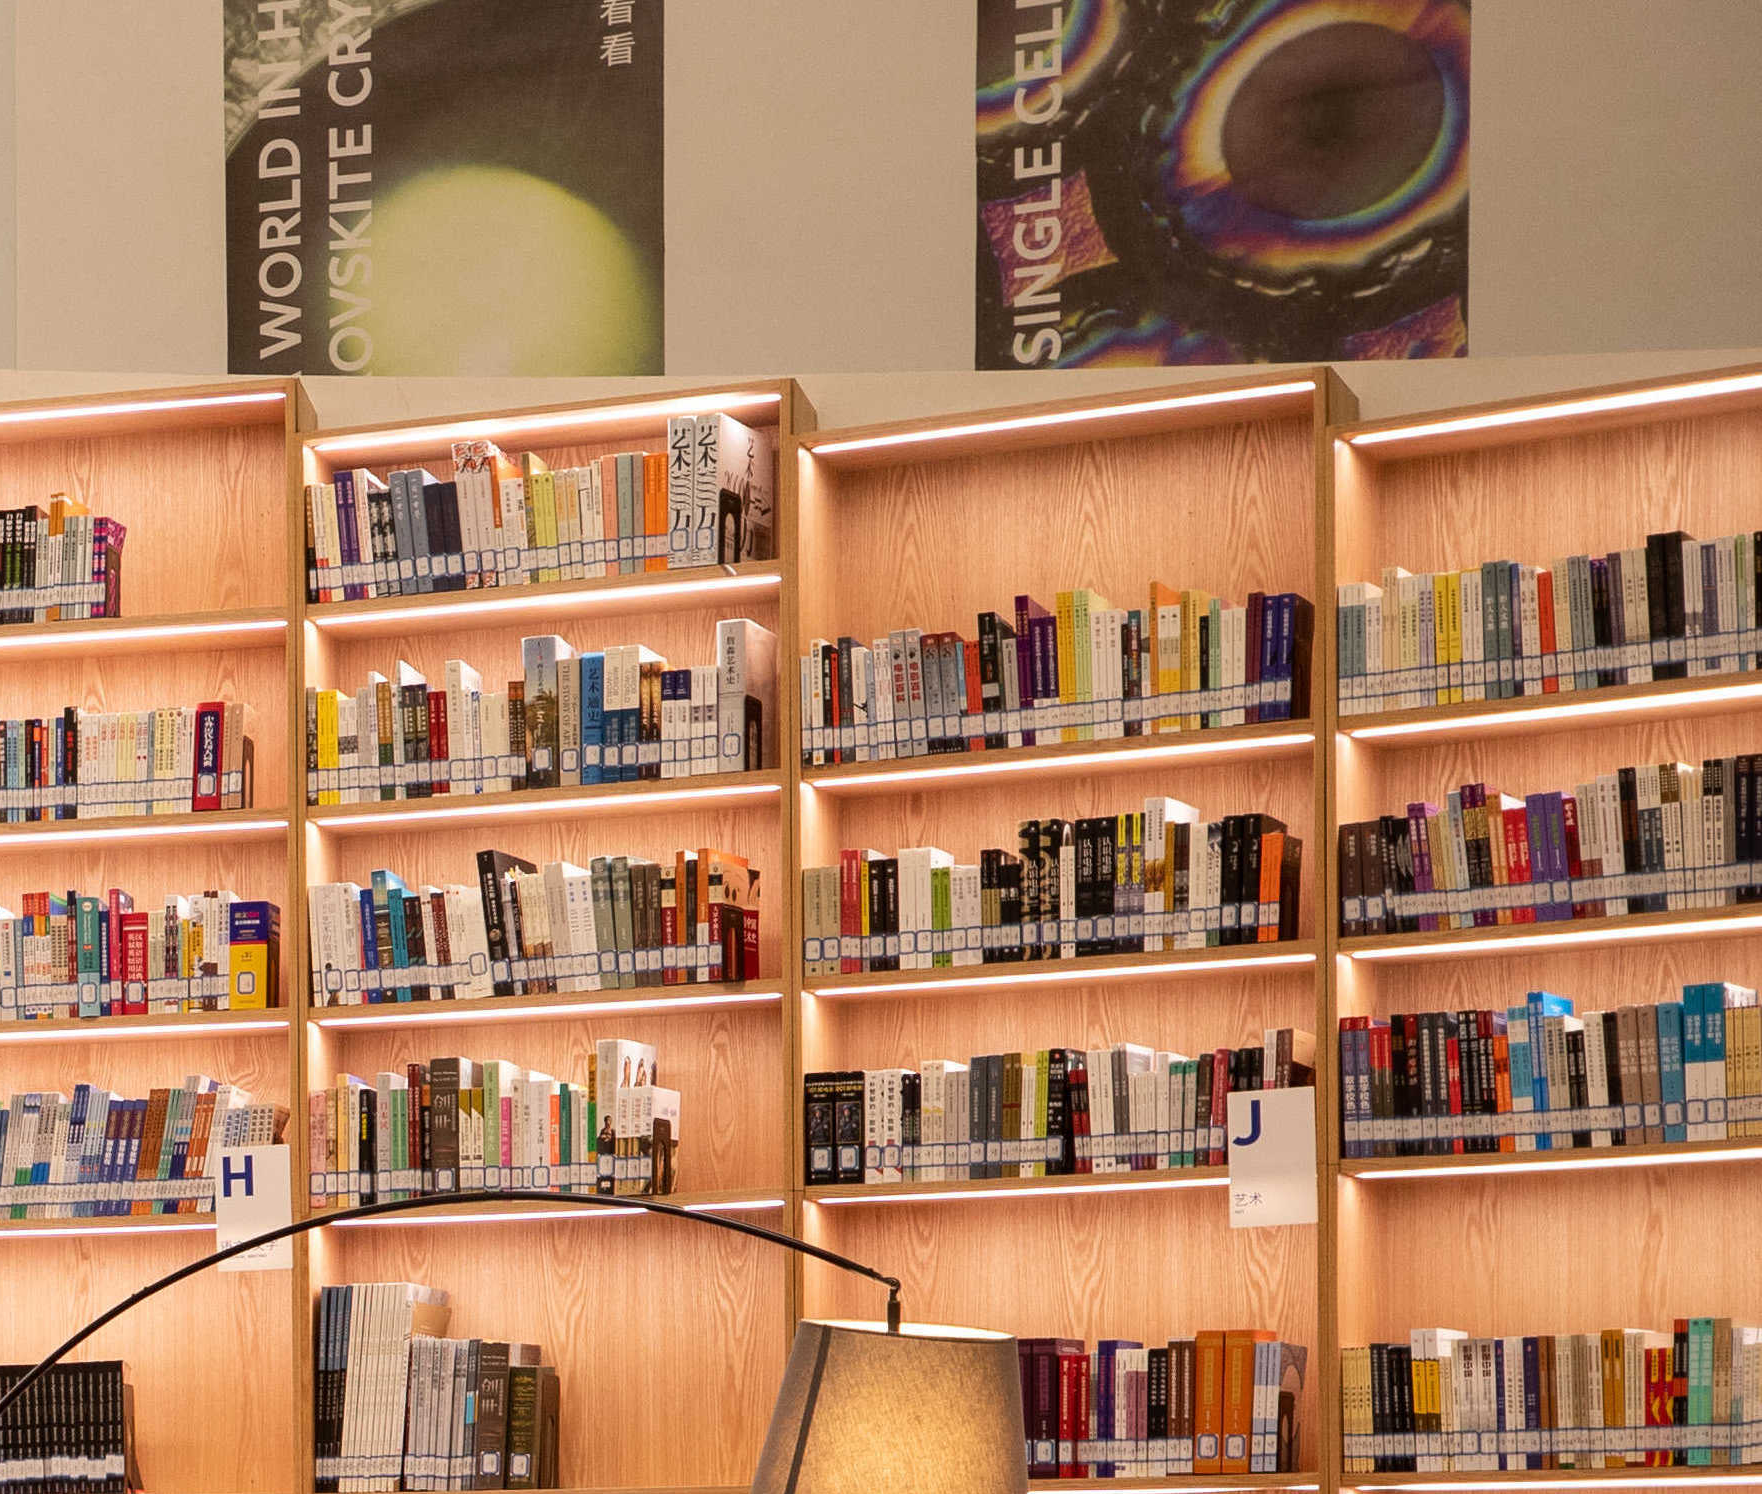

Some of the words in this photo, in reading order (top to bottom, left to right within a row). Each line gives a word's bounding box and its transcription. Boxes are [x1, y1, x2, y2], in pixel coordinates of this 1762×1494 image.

[258, 61, 301, 119] IN
[258, 138, 302, 360] WORLD
[327, 124, 373, 375] OVSKITE
[1013, 142, 1062, 365] SINGLE
[1232, 1099, 1261, 1147] J
[222, 1154, 254, 1198] H
[1234, 1191, 1263, 1208] 艺术
